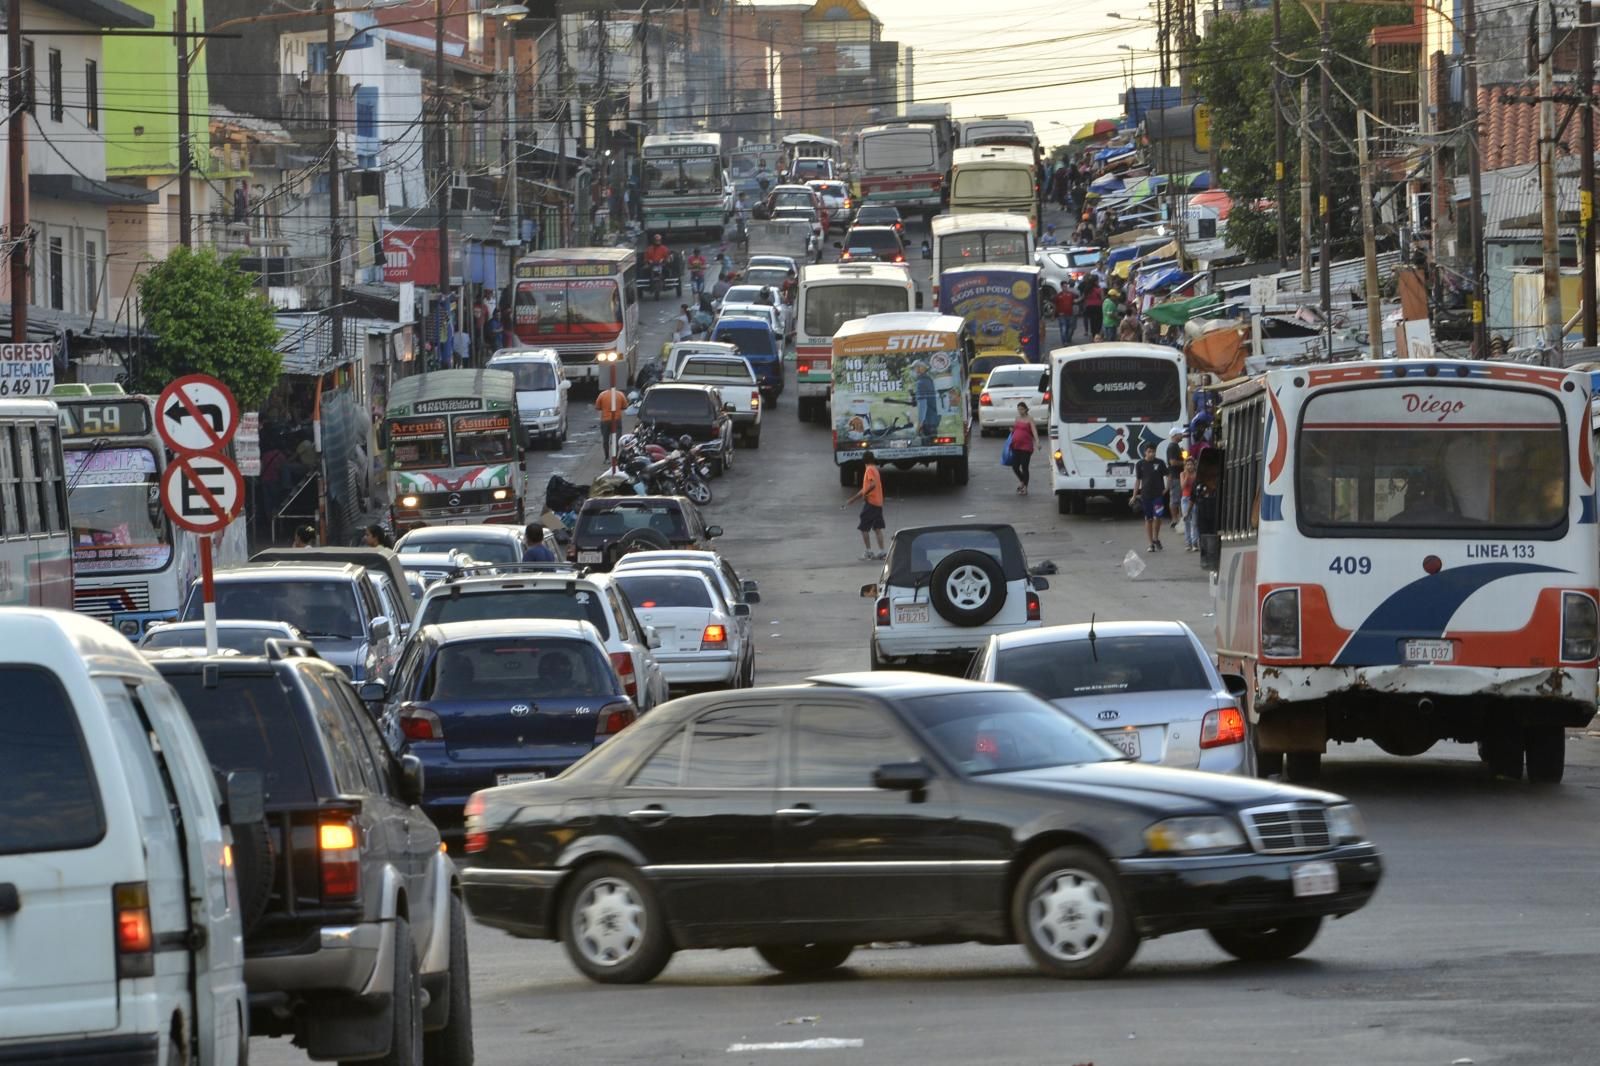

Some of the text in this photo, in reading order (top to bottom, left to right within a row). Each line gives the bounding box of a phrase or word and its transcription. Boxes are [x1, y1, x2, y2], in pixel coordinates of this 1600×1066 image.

[987, 286, 1010, 295] POLVO
[886, 334, 944, 350] STIHL
[0, 345, 52, 361] GRESO
[845, 359, 861, 370] NO
[847, 370, 889, 383] LUGAR
[854, 380, 903, 393] DENGUE
[1104, 382, 1135, 392] NISSAN
[1402, 393, 1466, 421] Diego
[83, 406, 120, 433] 59
[181, 466, 225, 516] E
[1466, 544, 1535, 559] LINEA 133
[1328, 556, 1372, 576] 409
[1074, 683, 1128, 692] www.kia.com.py
[1099, 711, 1118, 719] KIA
